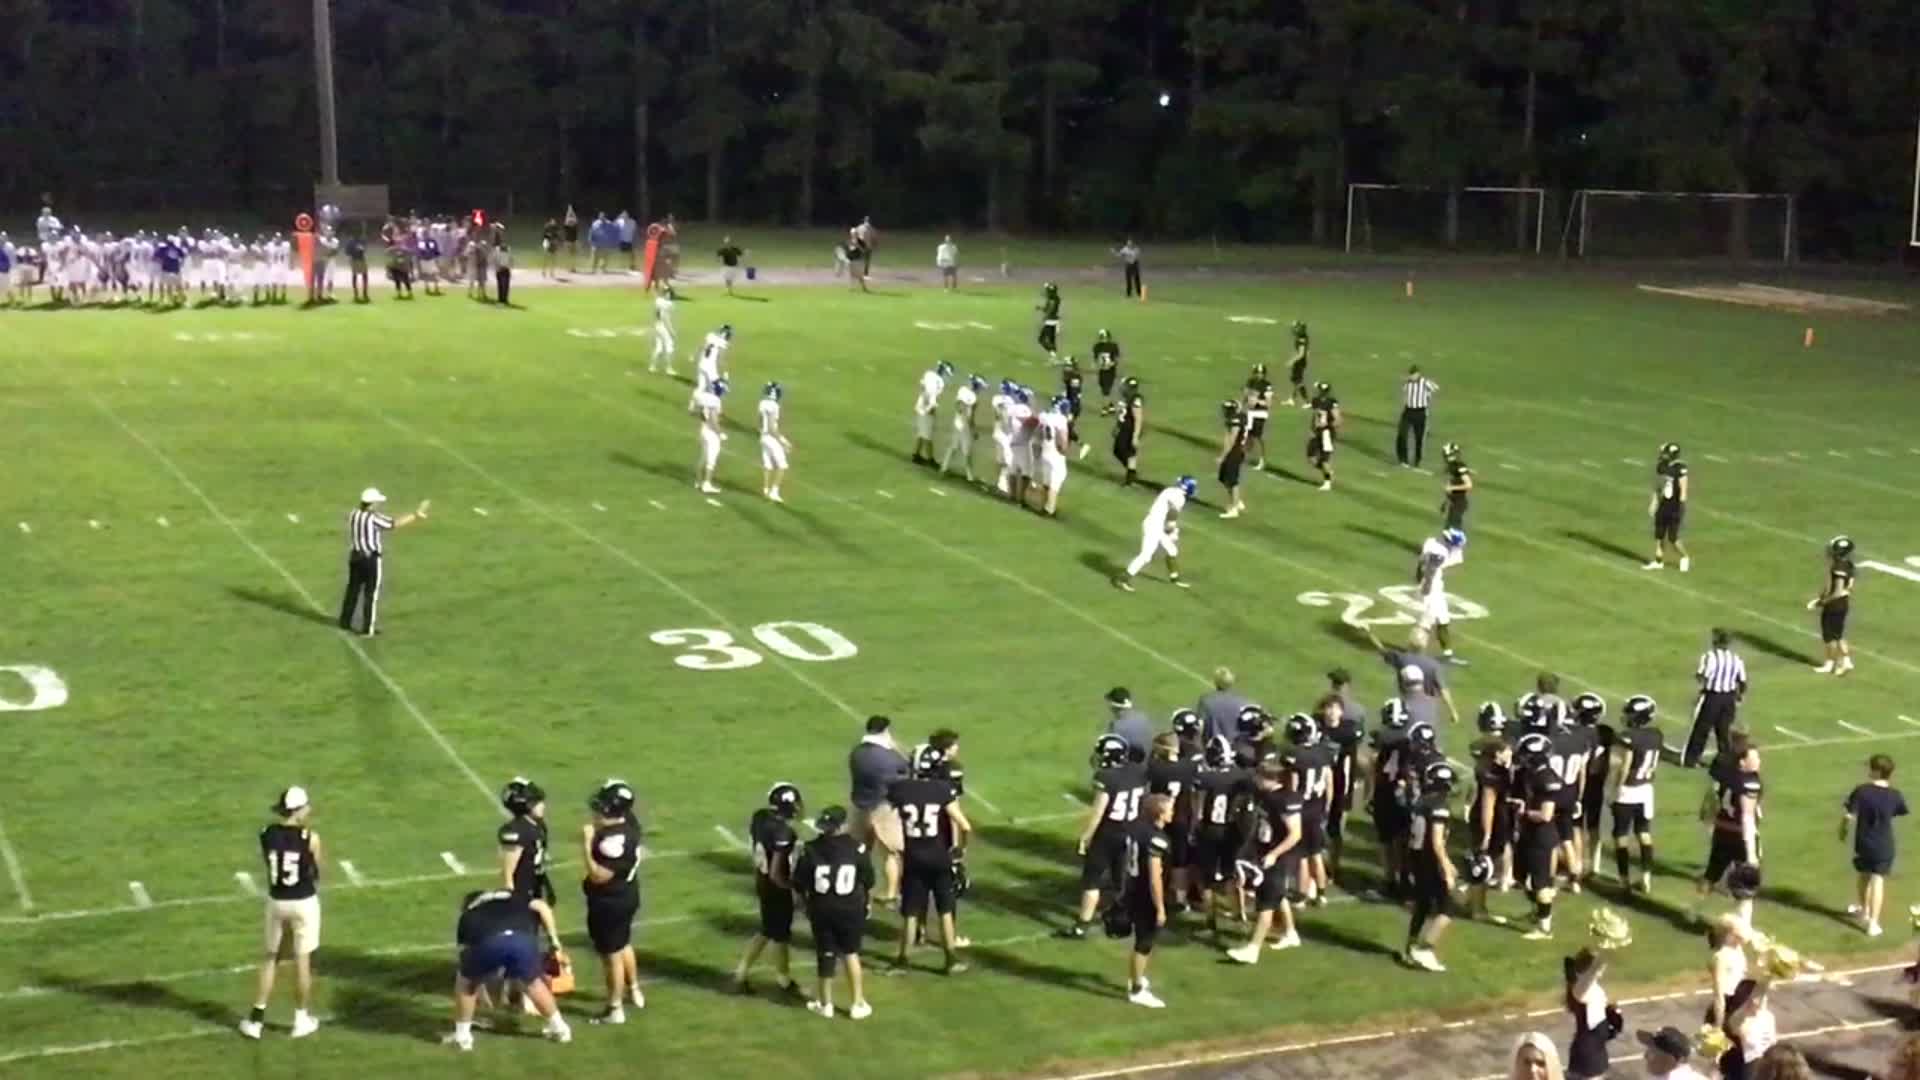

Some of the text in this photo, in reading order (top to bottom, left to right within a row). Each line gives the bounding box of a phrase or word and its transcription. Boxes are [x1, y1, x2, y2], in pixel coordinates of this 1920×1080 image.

[1296, 585, 1489, 626] 20
[649, 620, 859, 671] 30
[903, 803, 940, 838] 25
[1108, 788, 1144, 821] 55
[269, 850, 300, 887] 15
